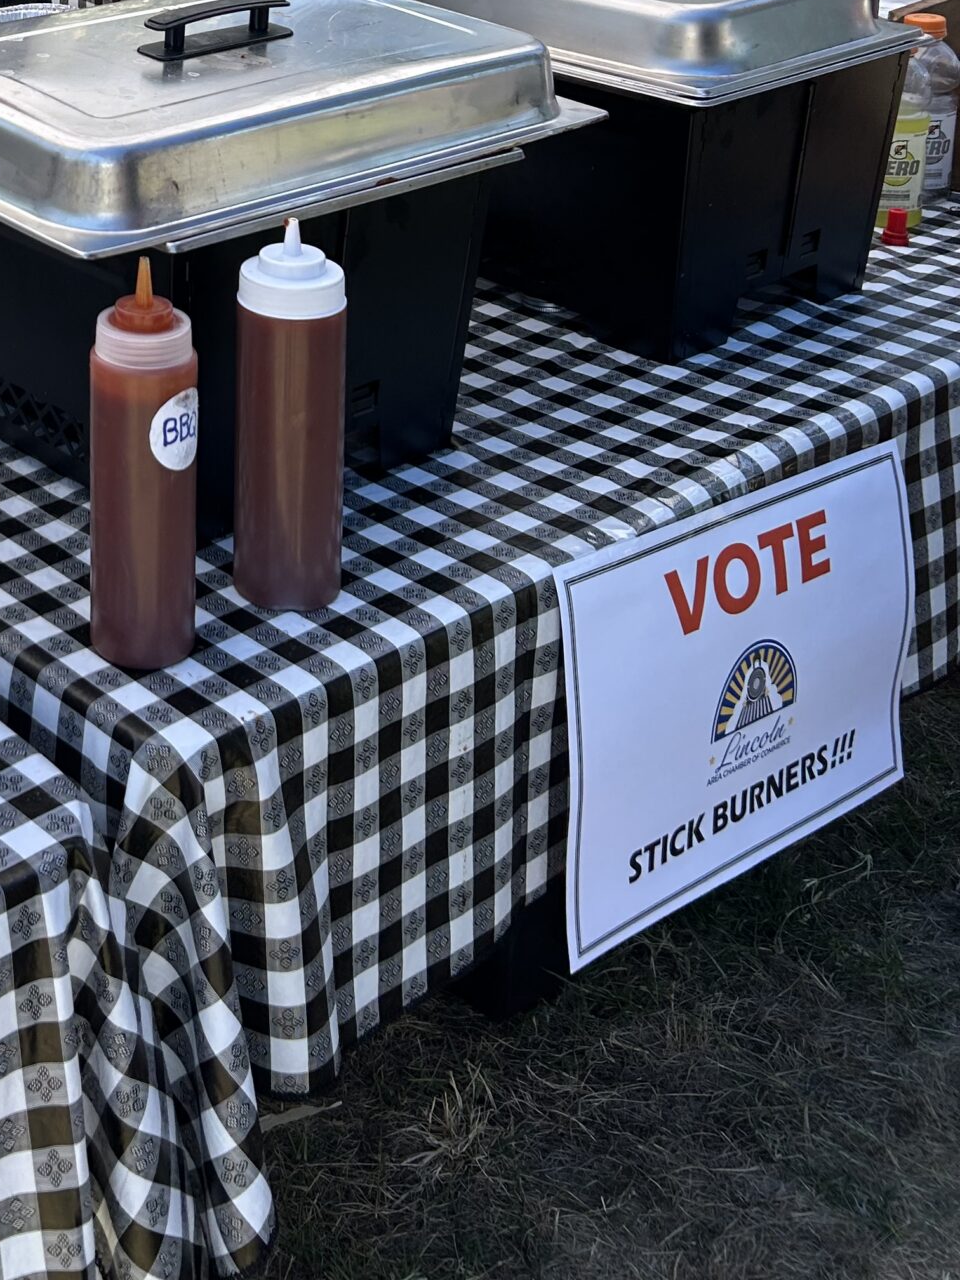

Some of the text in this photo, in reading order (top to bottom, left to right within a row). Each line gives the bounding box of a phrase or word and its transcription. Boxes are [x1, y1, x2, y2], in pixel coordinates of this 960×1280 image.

[885, 159, 921, 176] ERO
[664, 509, 831, 636] VOTE
[706, 735, 791, 787] AREA CHAMBER OF COMMERCE
[714, 714, 787, 774] Lincoln
[628, 728, 856, 884] STICK BURNERS!!!
